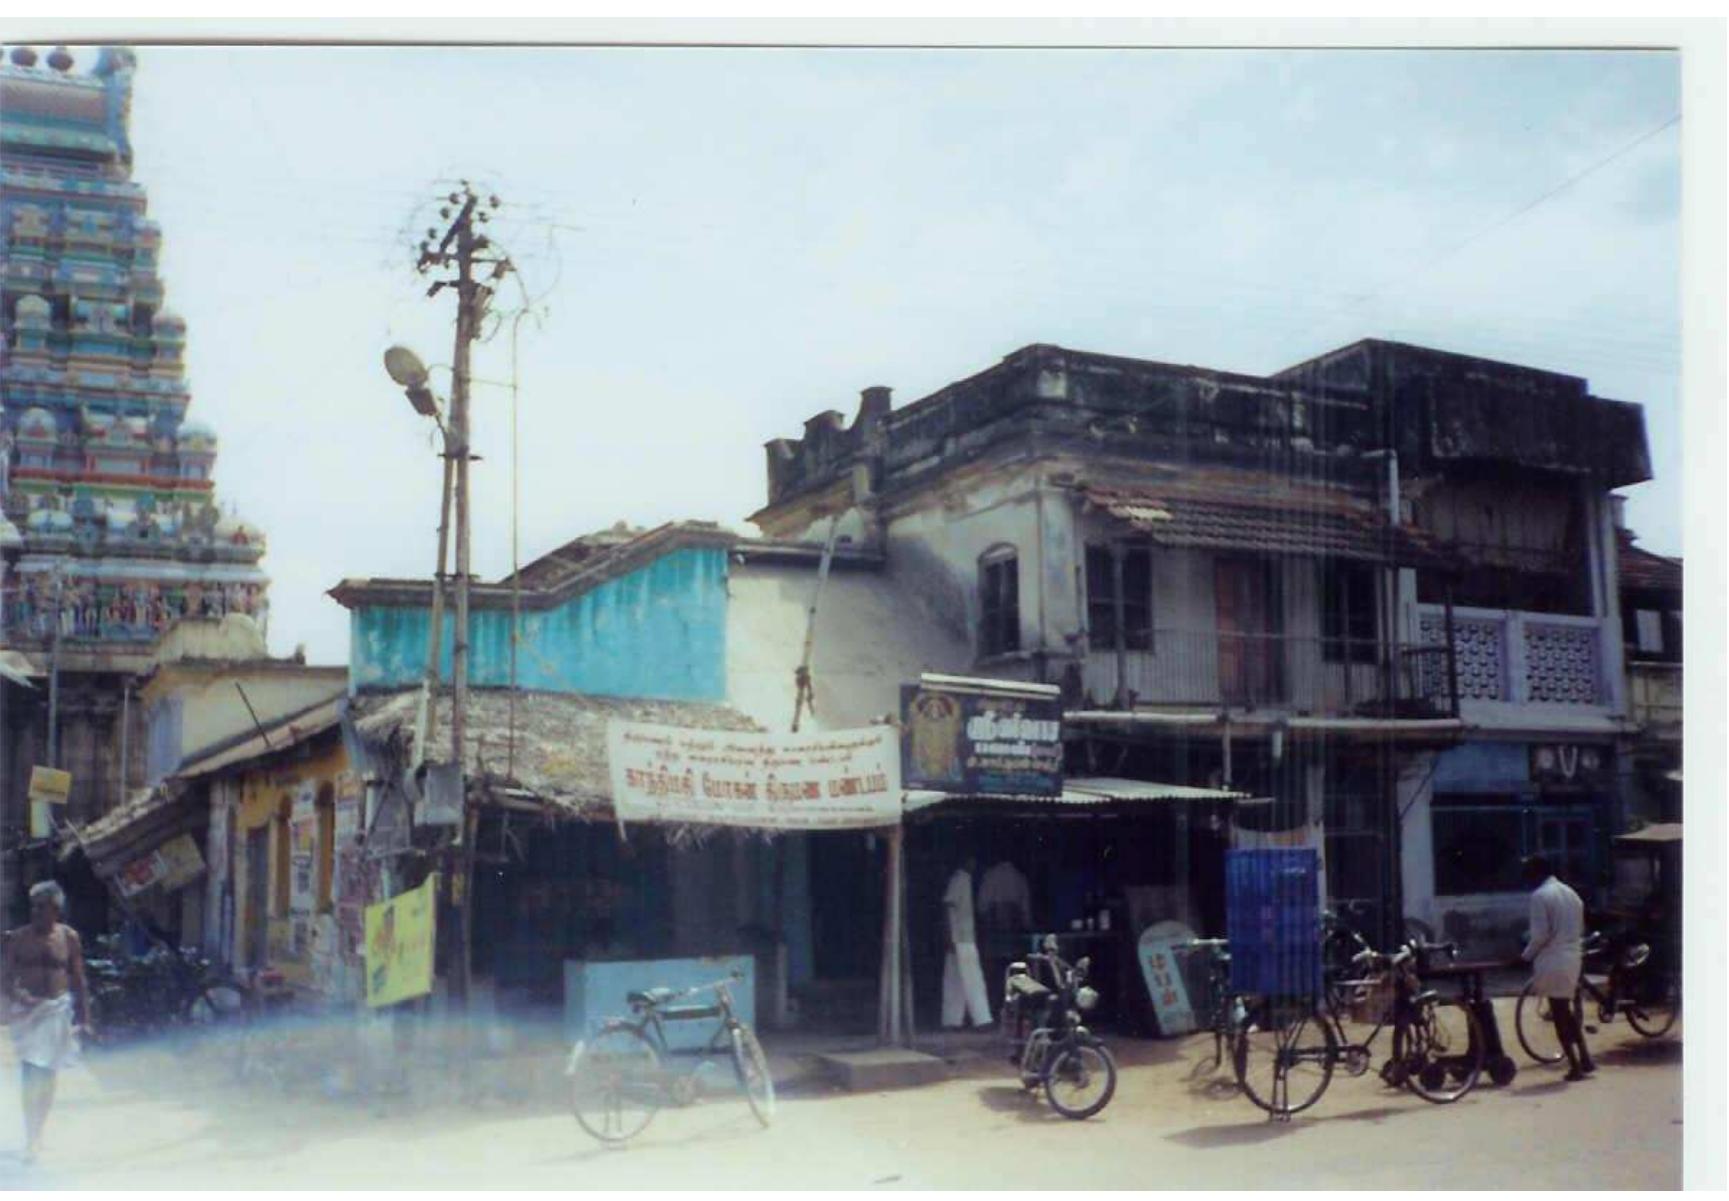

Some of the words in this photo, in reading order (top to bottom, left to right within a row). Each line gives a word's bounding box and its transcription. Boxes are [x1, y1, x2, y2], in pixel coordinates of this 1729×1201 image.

[702, 771, 758, 801] மோகன்
[765, 772, 821, 802] திருமண
[828, 763, 888, 799] மண்டபம்
